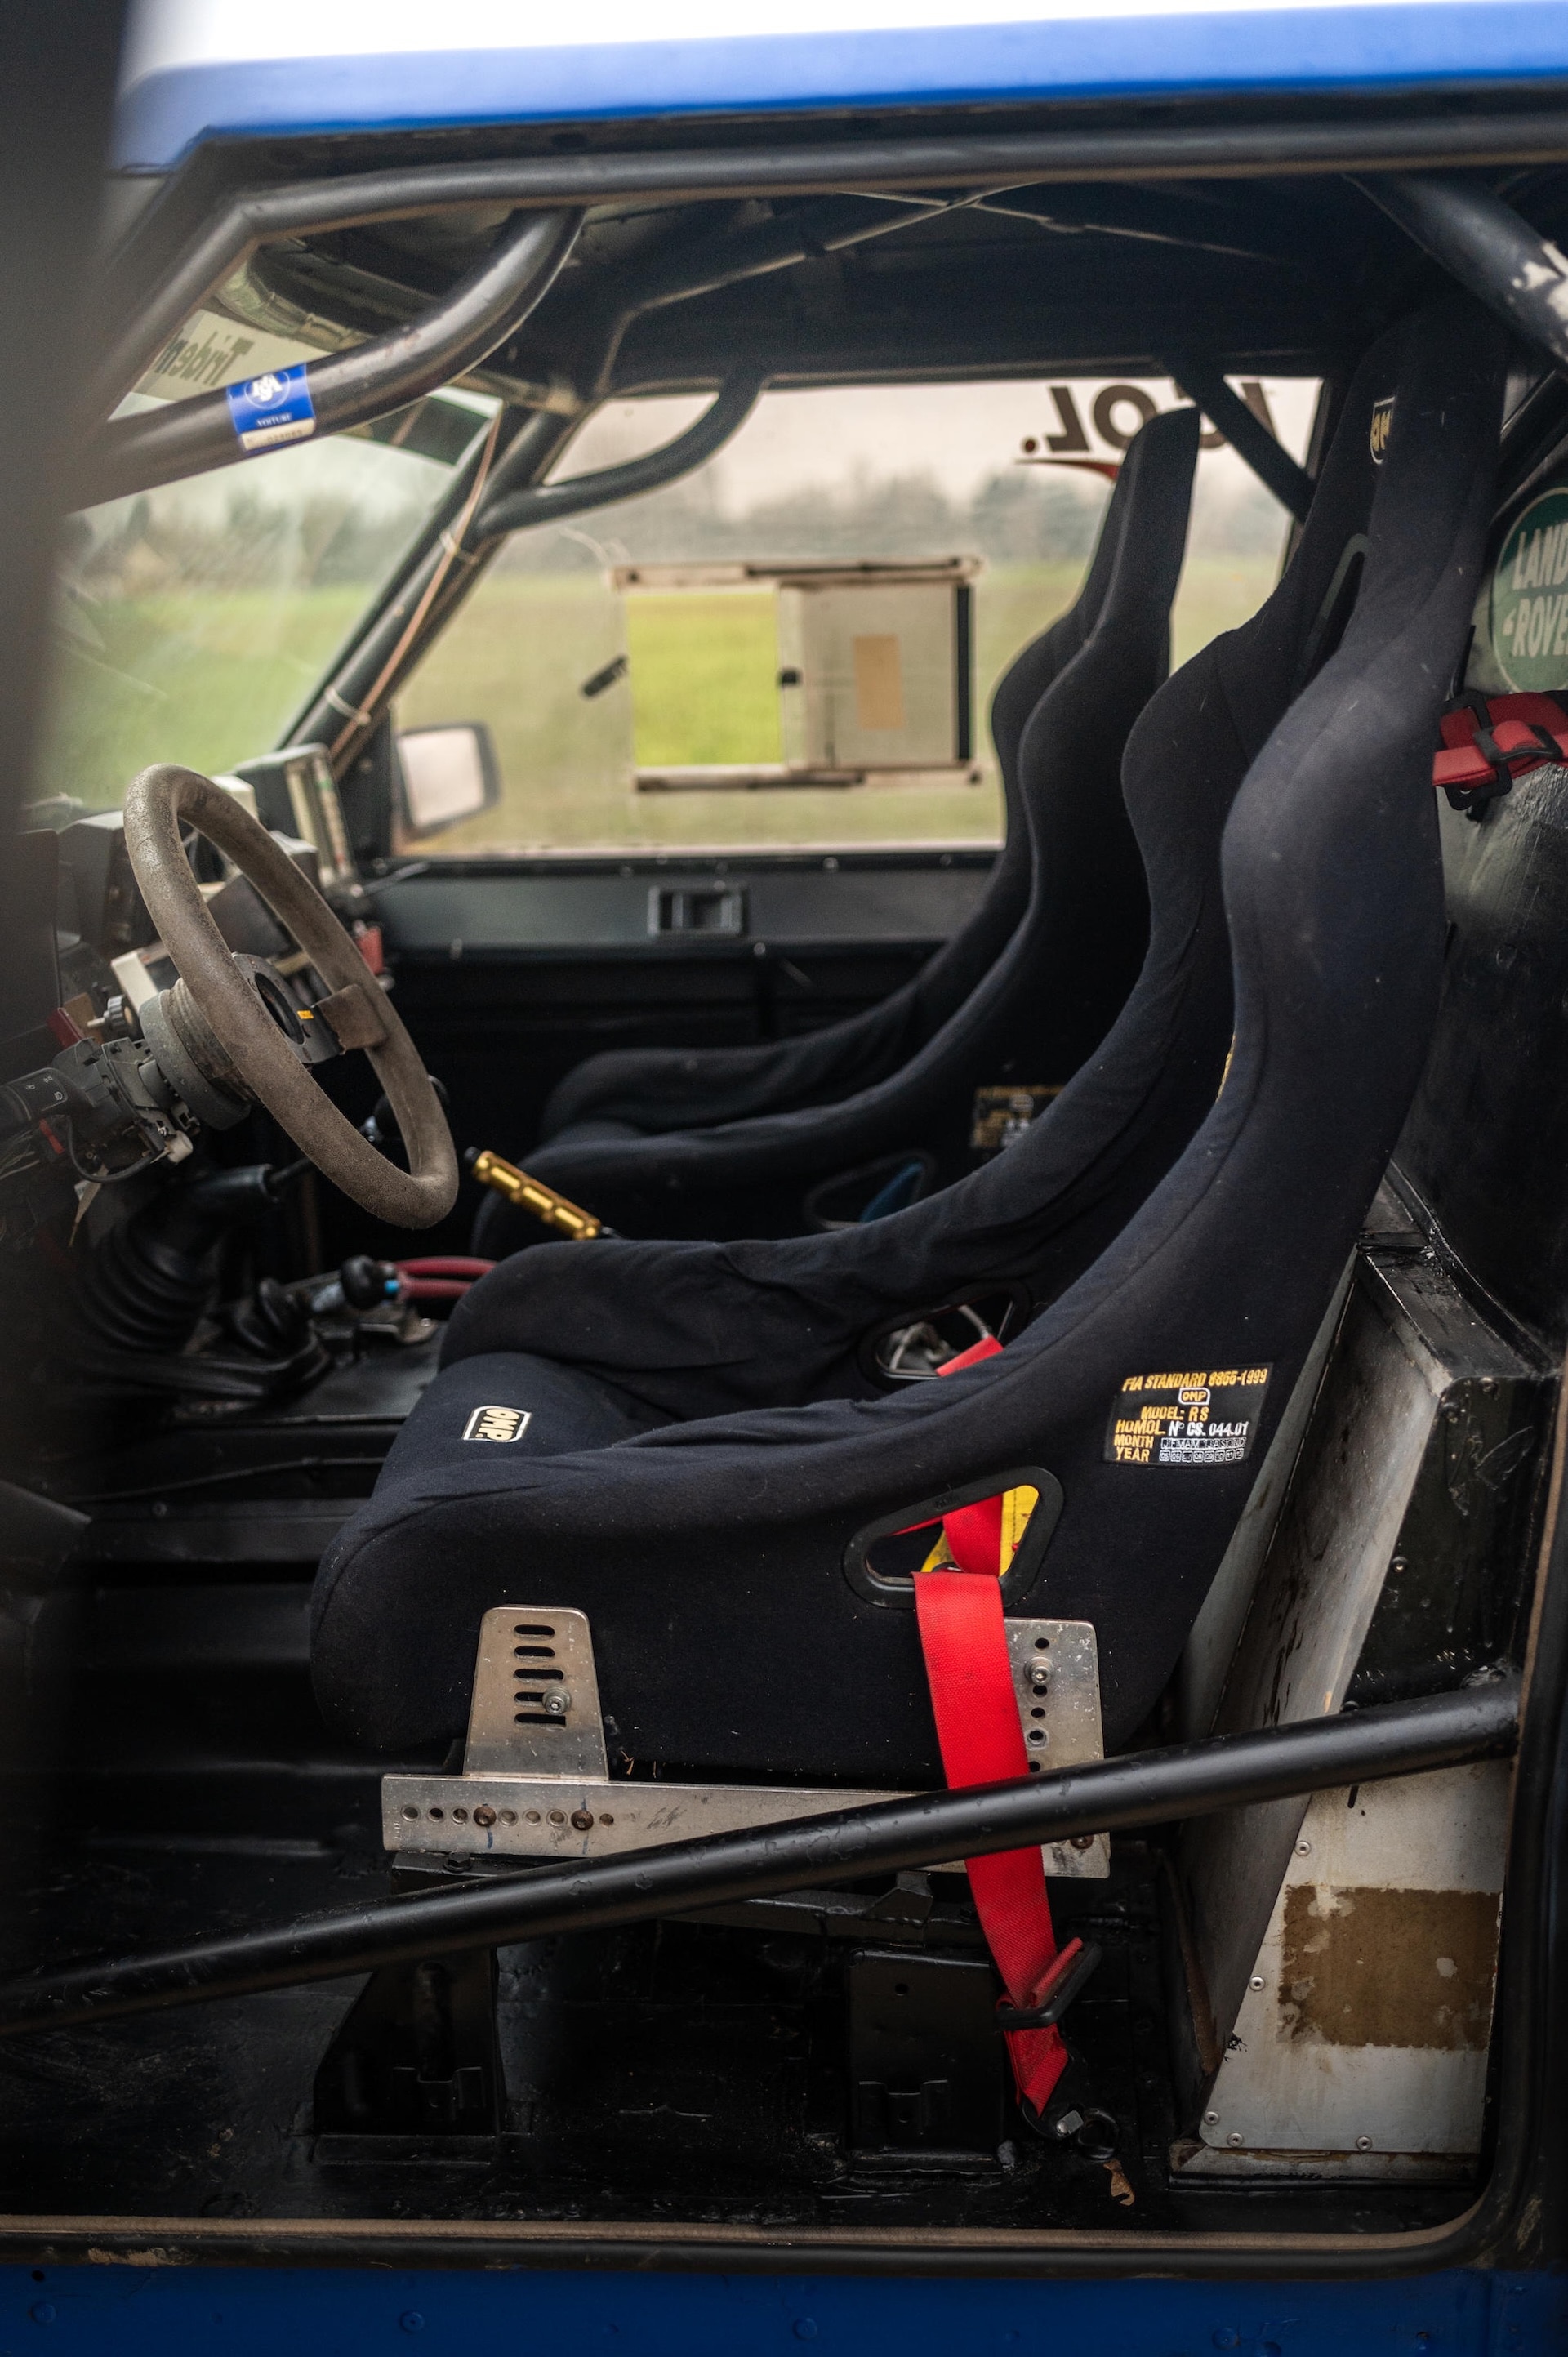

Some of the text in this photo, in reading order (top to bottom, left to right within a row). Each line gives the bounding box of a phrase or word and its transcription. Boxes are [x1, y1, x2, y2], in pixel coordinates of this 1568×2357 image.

[1371, 410, 1392, 452] OM
[1512, 593, 1568, 658] ROVE
[1122, 1368, 1268, 1392] FIA STANDARD 8855-1999
[1182, 1390, 1207, 1402] OMP
[1140, 1406, 1185, 1422] MODEL:
[1114, 1434, 1154, 1449] MONTH
[1116, 1446, 1150, 1462] YEAR
